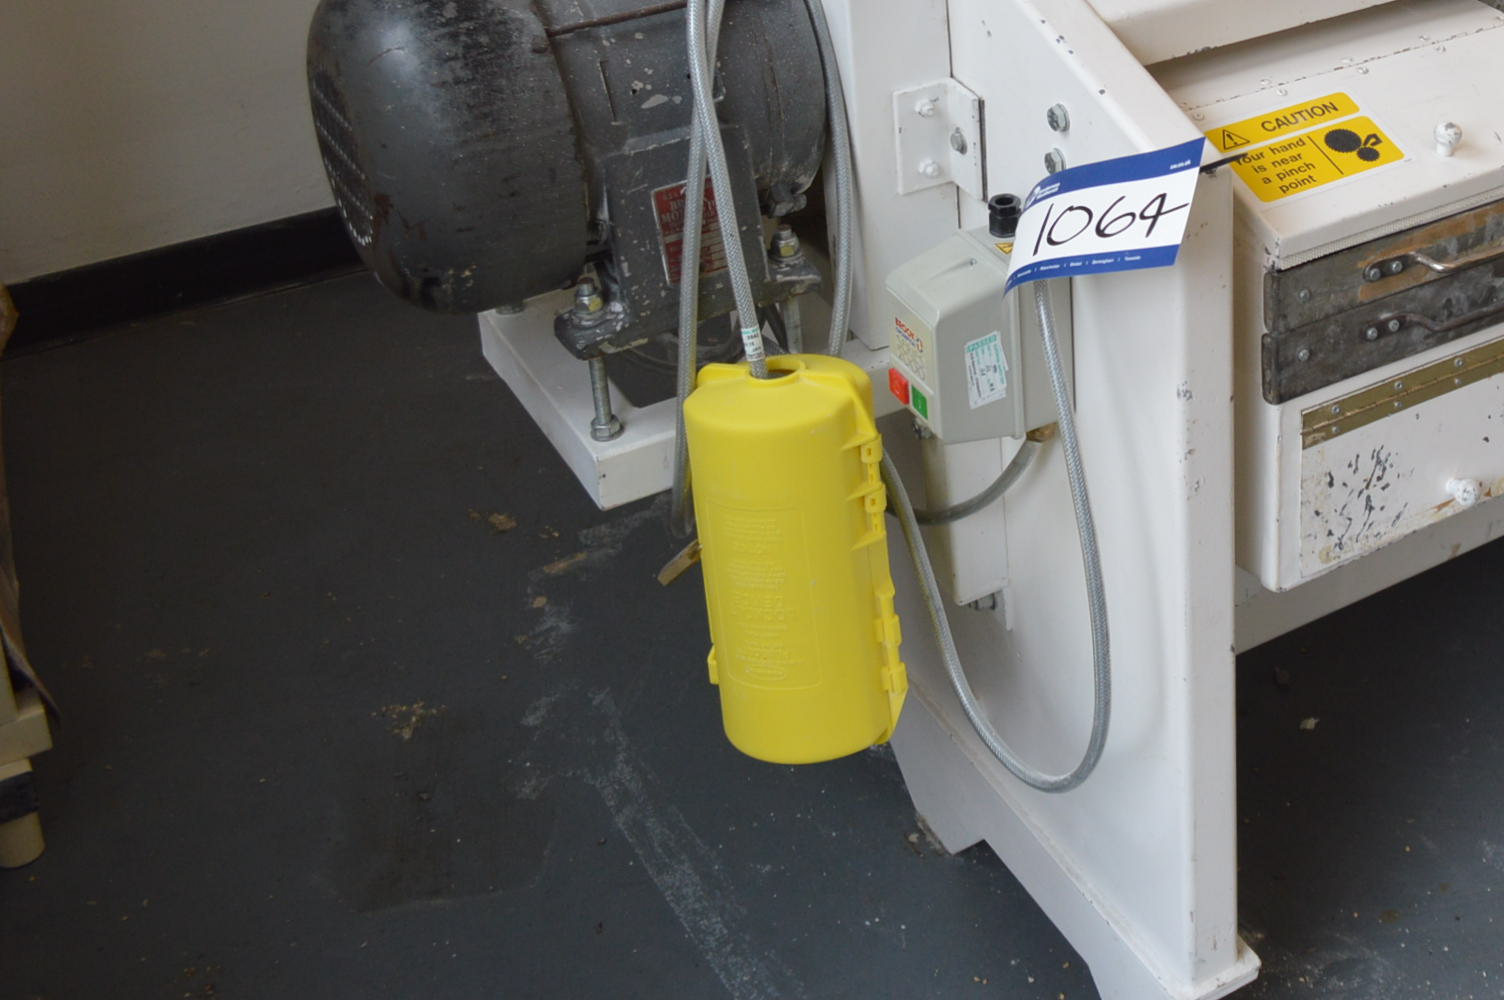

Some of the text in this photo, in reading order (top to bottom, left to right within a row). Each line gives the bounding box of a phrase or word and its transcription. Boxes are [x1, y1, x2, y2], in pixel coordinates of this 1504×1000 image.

[1261, 101, 1339, 132] CAUTION
[1269, 137, 1306, 155] hand
[1251, 152, 1303, 174] is near
[1262, 161, 1316, 185] a pinch
[1279, 174, 1318, 194] point
[1032, 192, 1190, 257] 1064
